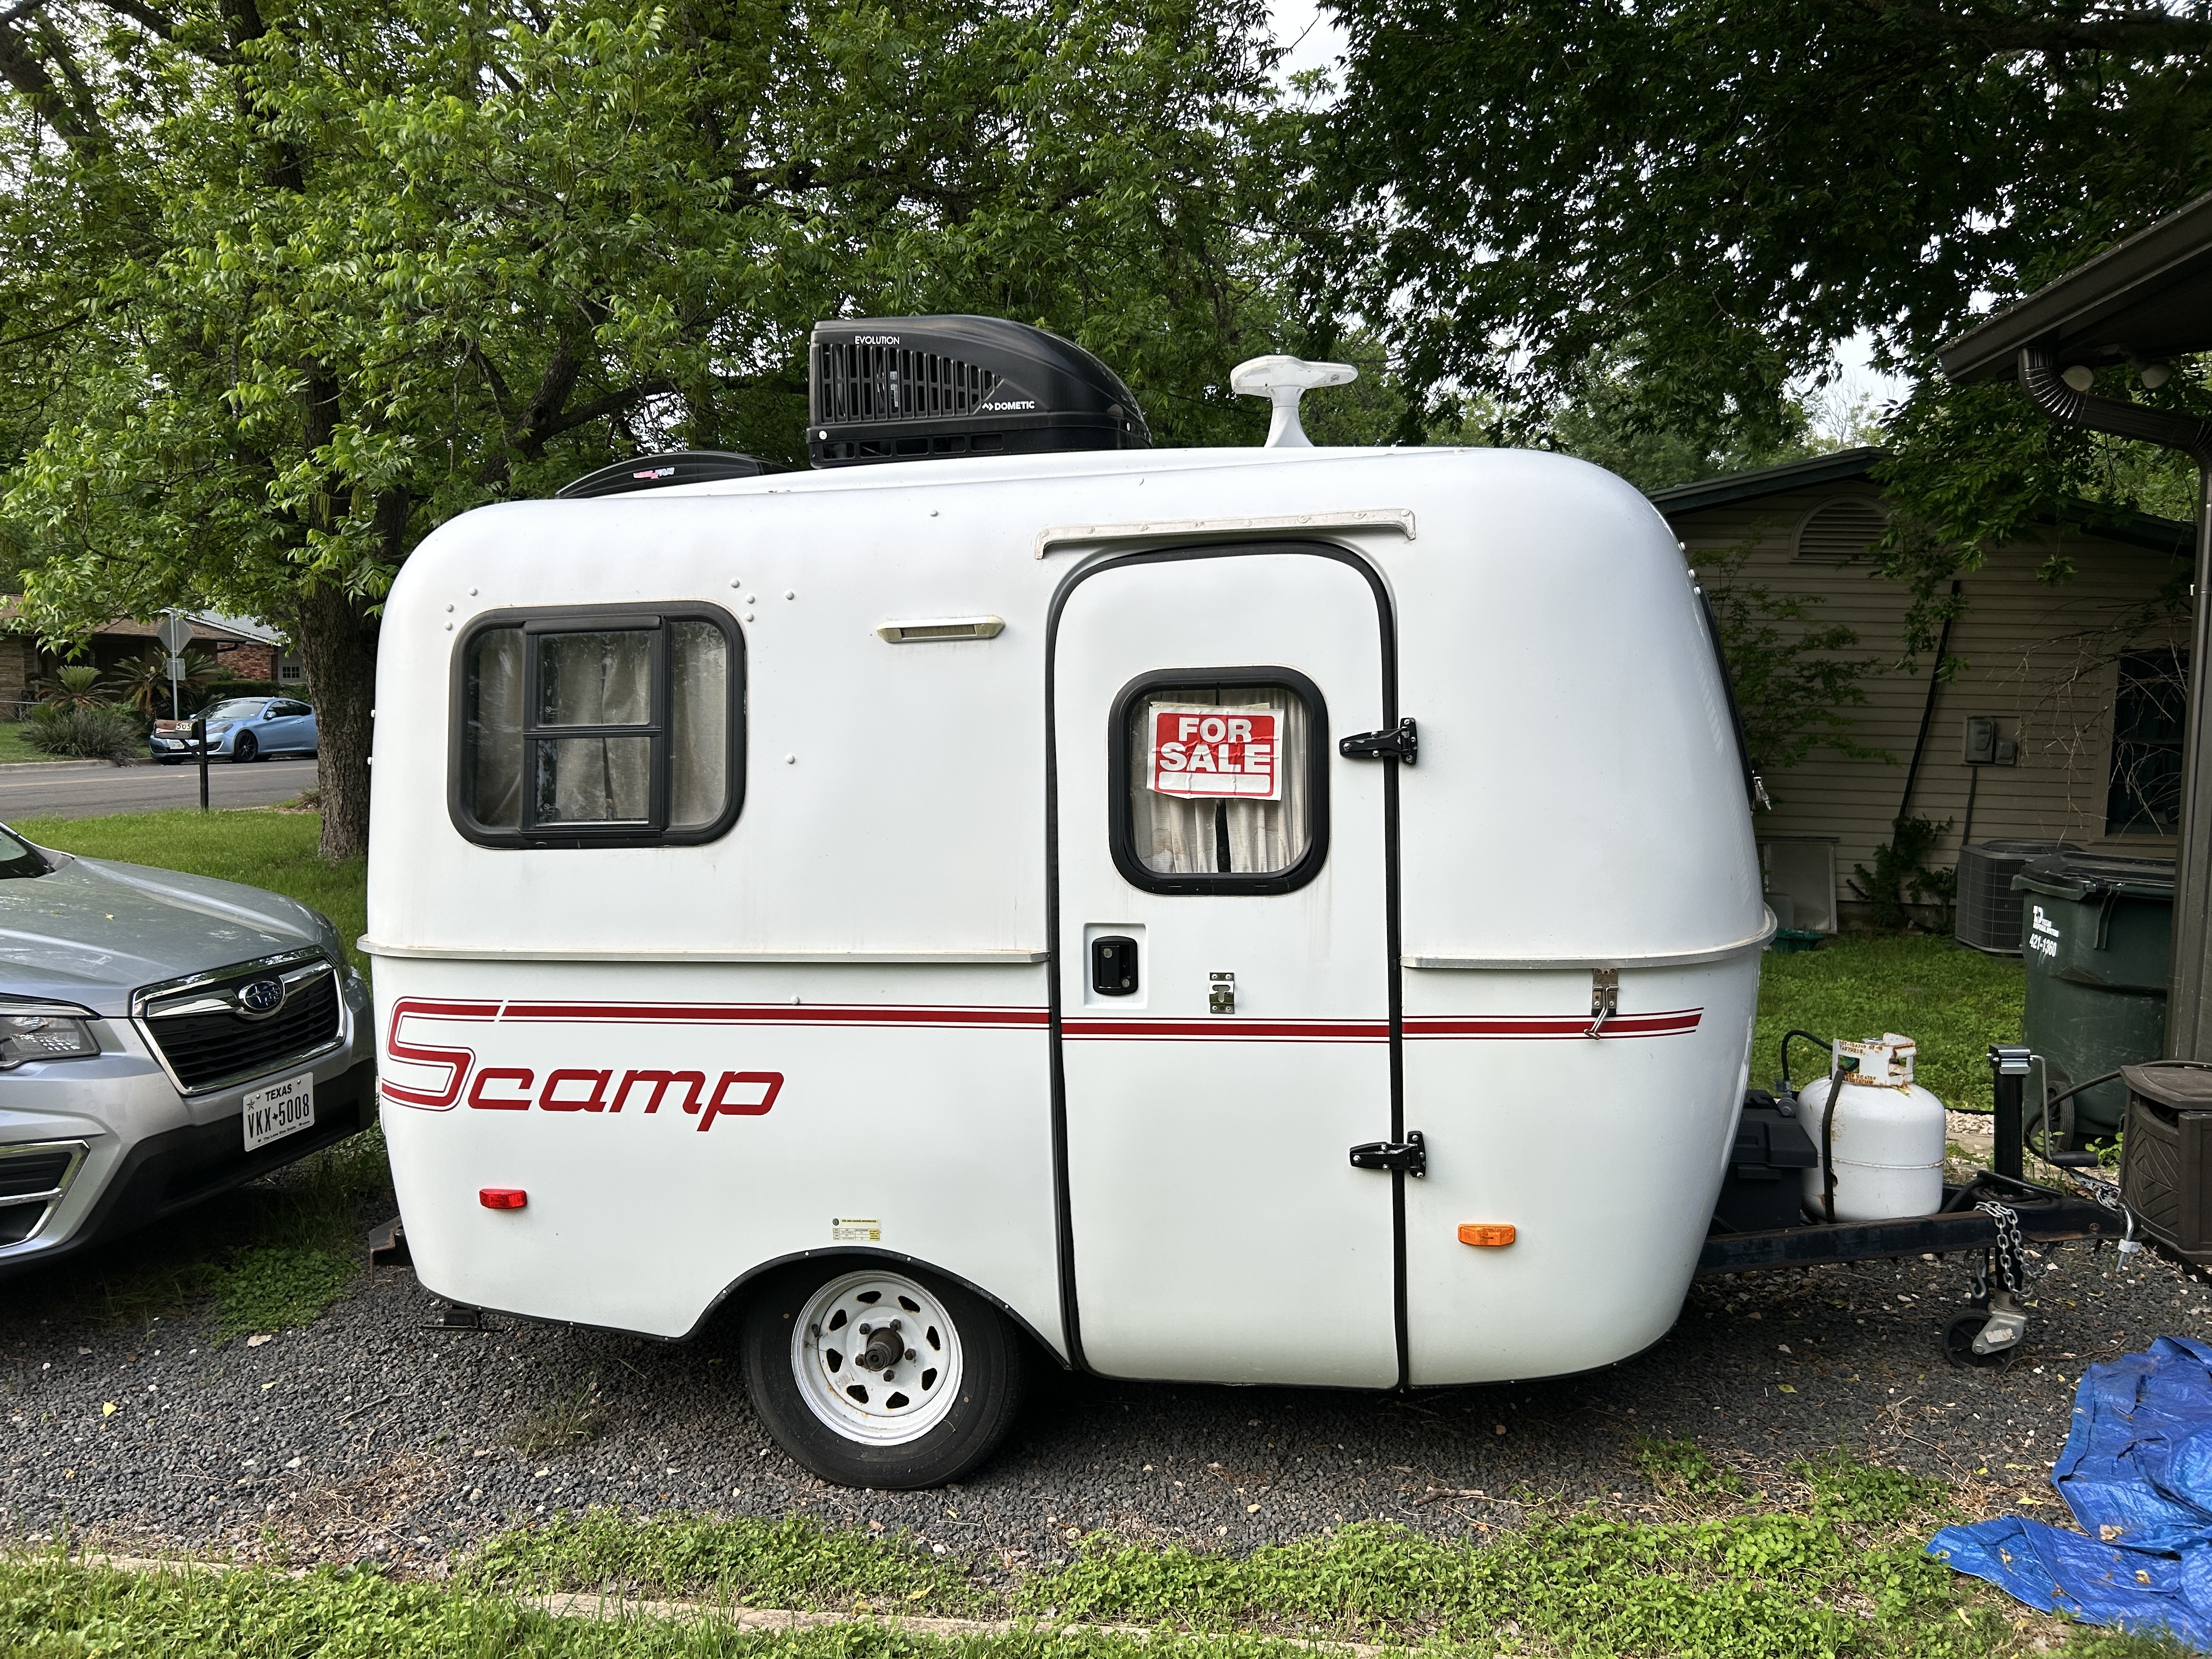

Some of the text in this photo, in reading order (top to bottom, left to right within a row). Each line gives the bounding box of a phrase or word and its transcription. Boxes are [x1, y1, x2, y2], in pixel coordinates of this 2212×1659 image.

[855, 335, 900, 345] EVOLUTION
[994, 400, 1035, 411] DOMETIC
[1178, 716, 1252, 743] FOR
[1159, 742, 1271, 773] SALE
[2029, 933, 2057, 957] 421-1360
[382, 996, 784, 1132] Scamp
[265, 1084, 292, 1102] TEXAS
[248, 1093, 309, 1138] VKX 5008
